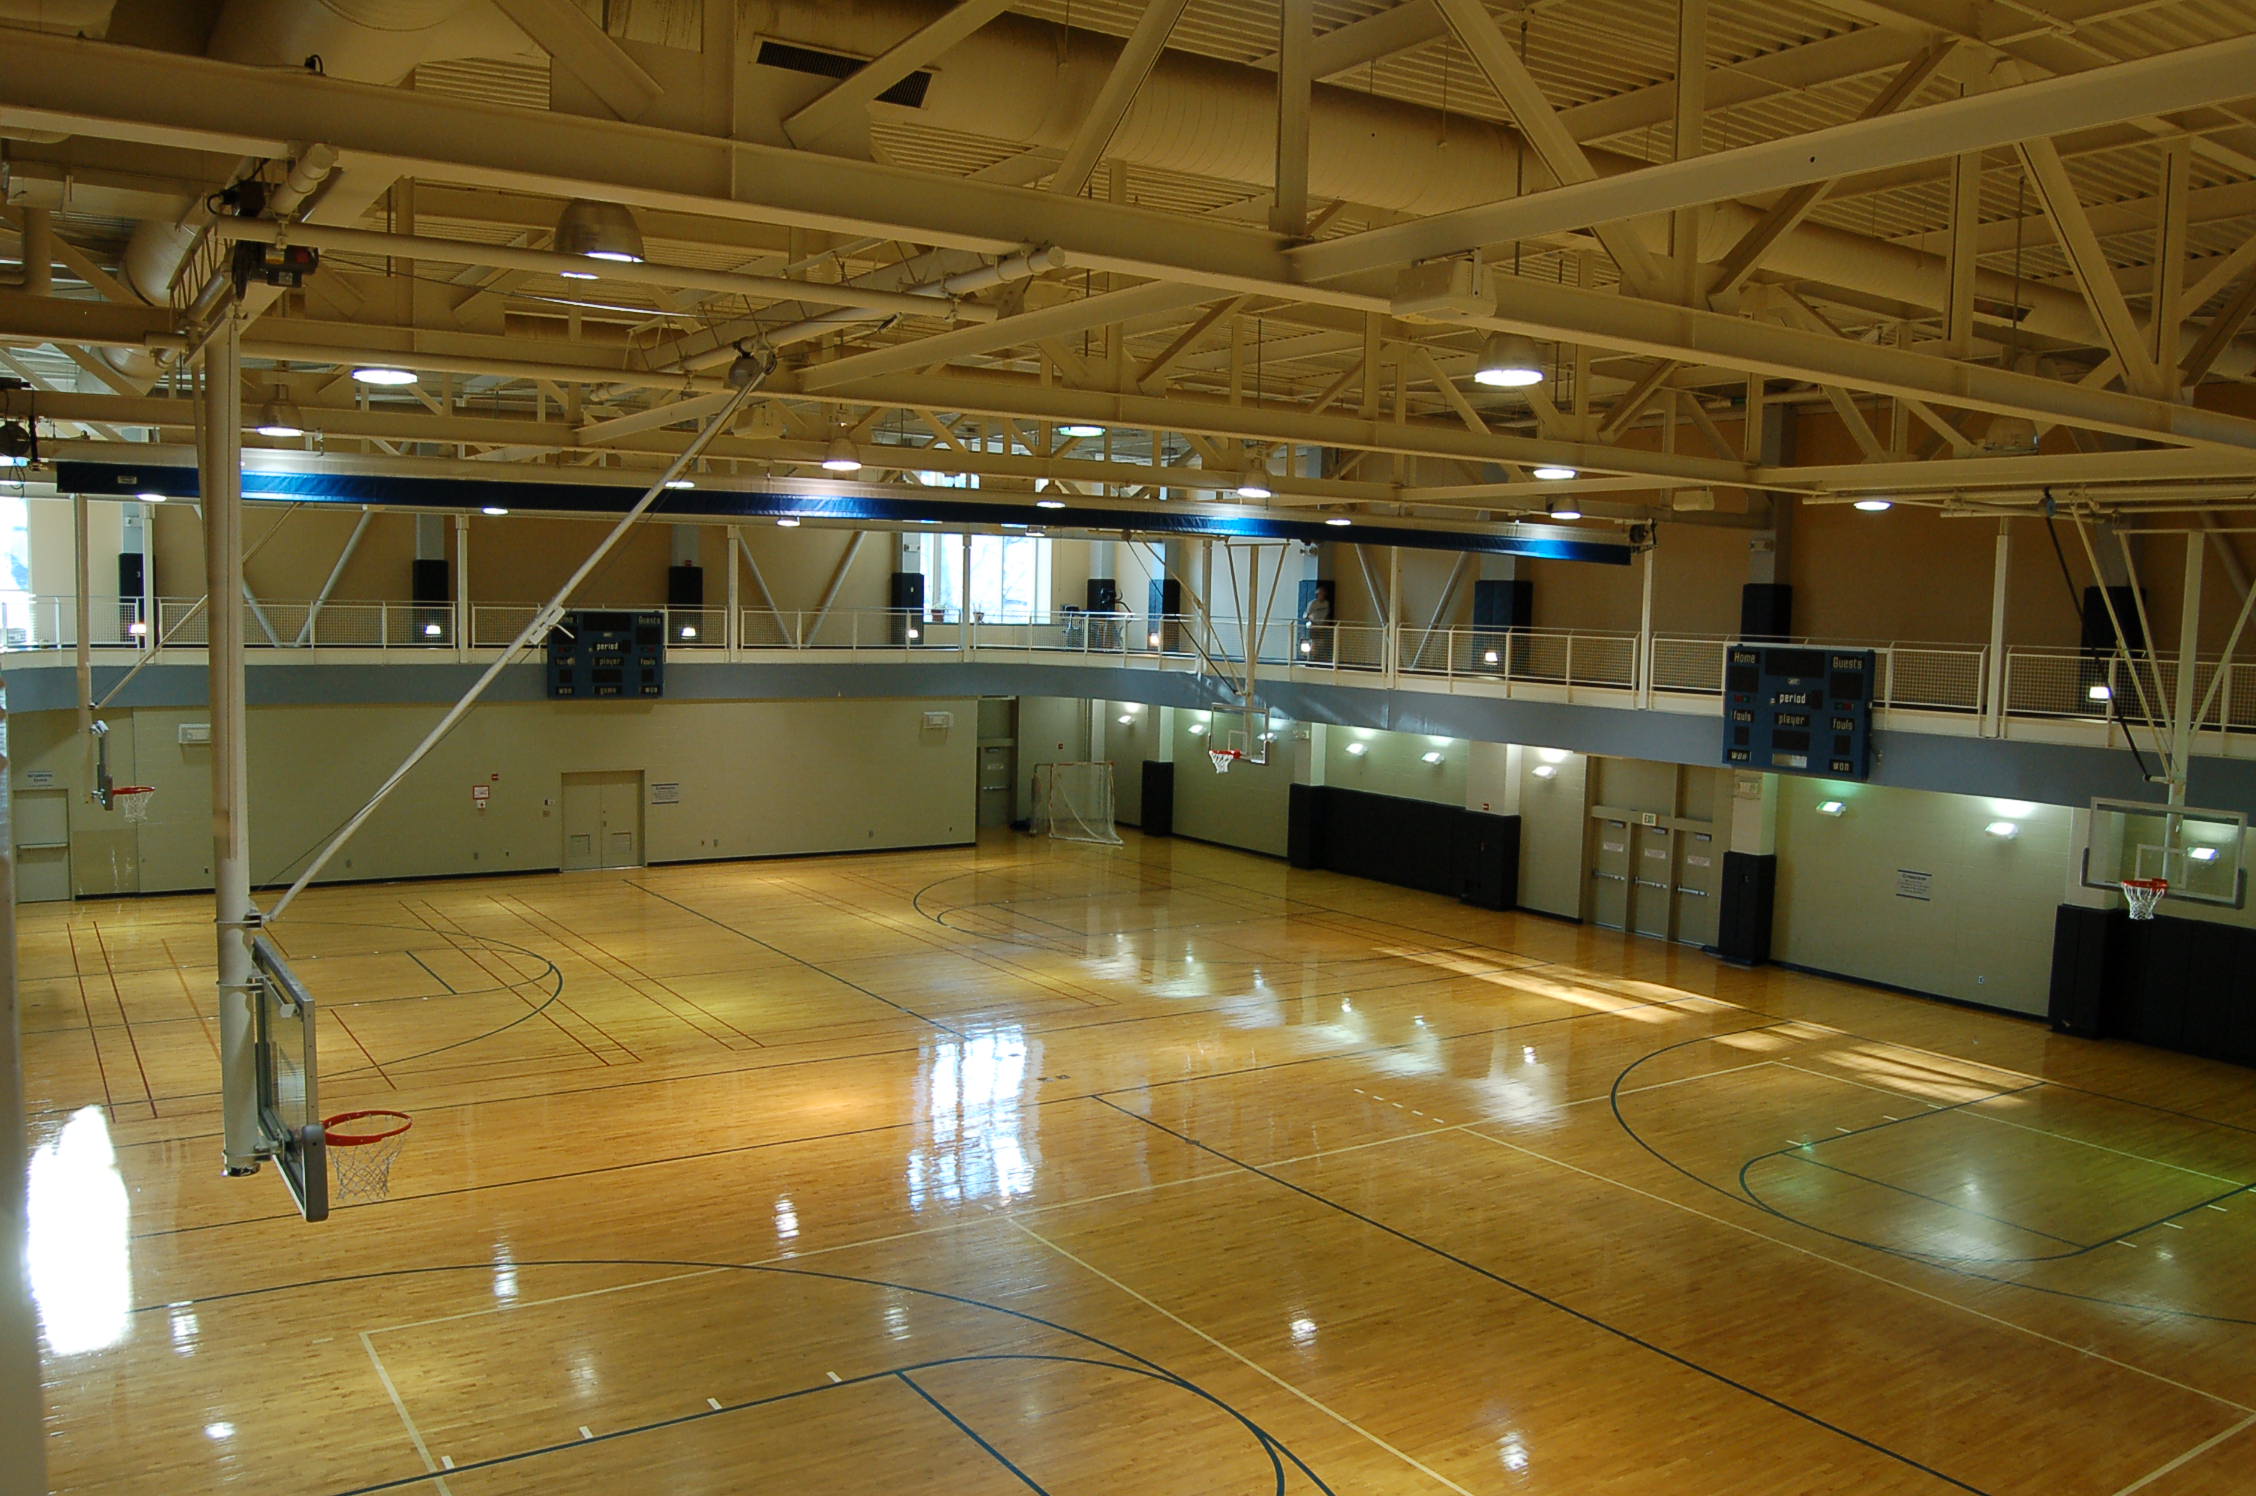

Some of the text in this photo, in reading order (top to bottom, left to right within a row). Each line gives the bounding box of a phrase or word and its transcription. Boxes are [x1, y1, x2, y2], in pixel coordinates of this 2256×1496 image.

[596, 642, 619, 651] period
[1734, 651, 1756, 664] Home
[1832, 656, 1863, 670] Guests
[1779, 693, 1806, 704] period
[1733, 709, 1752, 721] fouls
[1778, 714, 1805, 728] player
[1832, 718, 1853, 730] fouls
[1731, 751, 1748, 760] won
[1833, 761, 1850, 771] won
